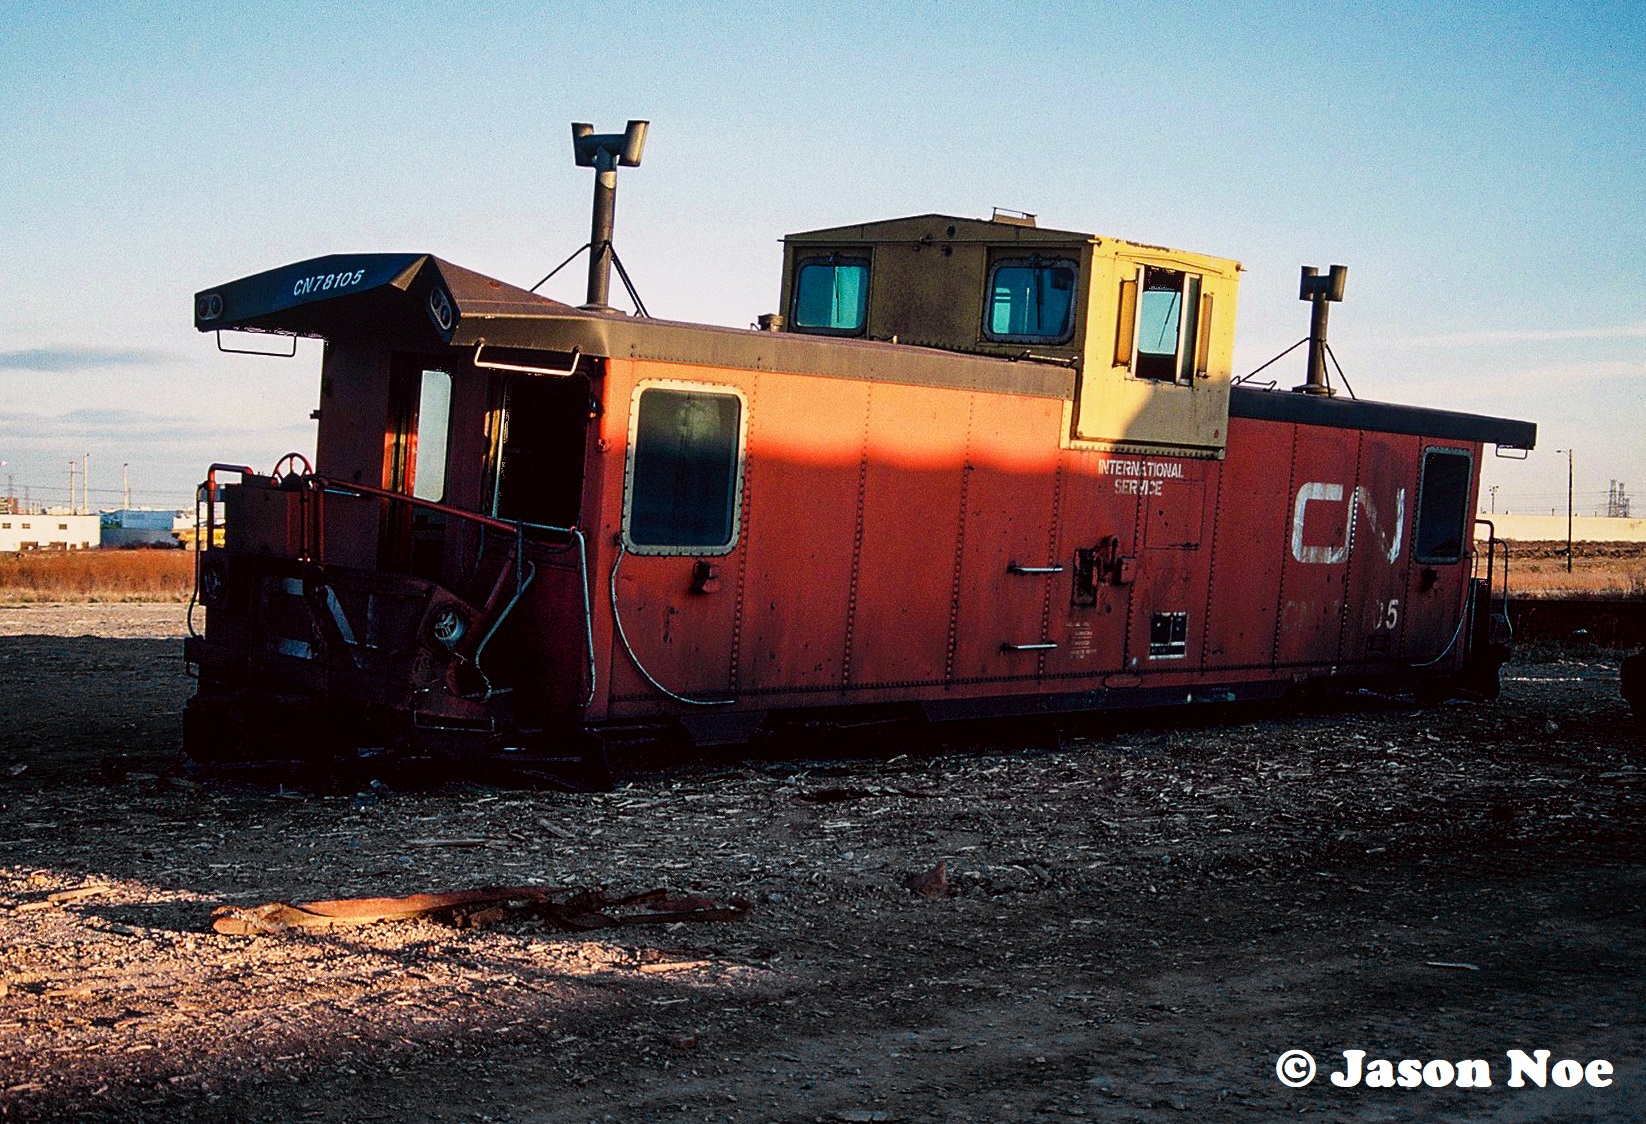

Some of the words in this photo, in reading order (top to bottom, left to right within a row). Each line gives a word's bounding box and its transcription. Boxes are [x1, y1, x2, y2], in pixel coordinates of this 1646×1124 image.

[293, 269, 366, 296] CN78105
[1098, 459, 1184, 479] INTERNATIONAL
[1114, 478, 1163, 496] SERVICE
[1292, 482, 1405, 564] CN
